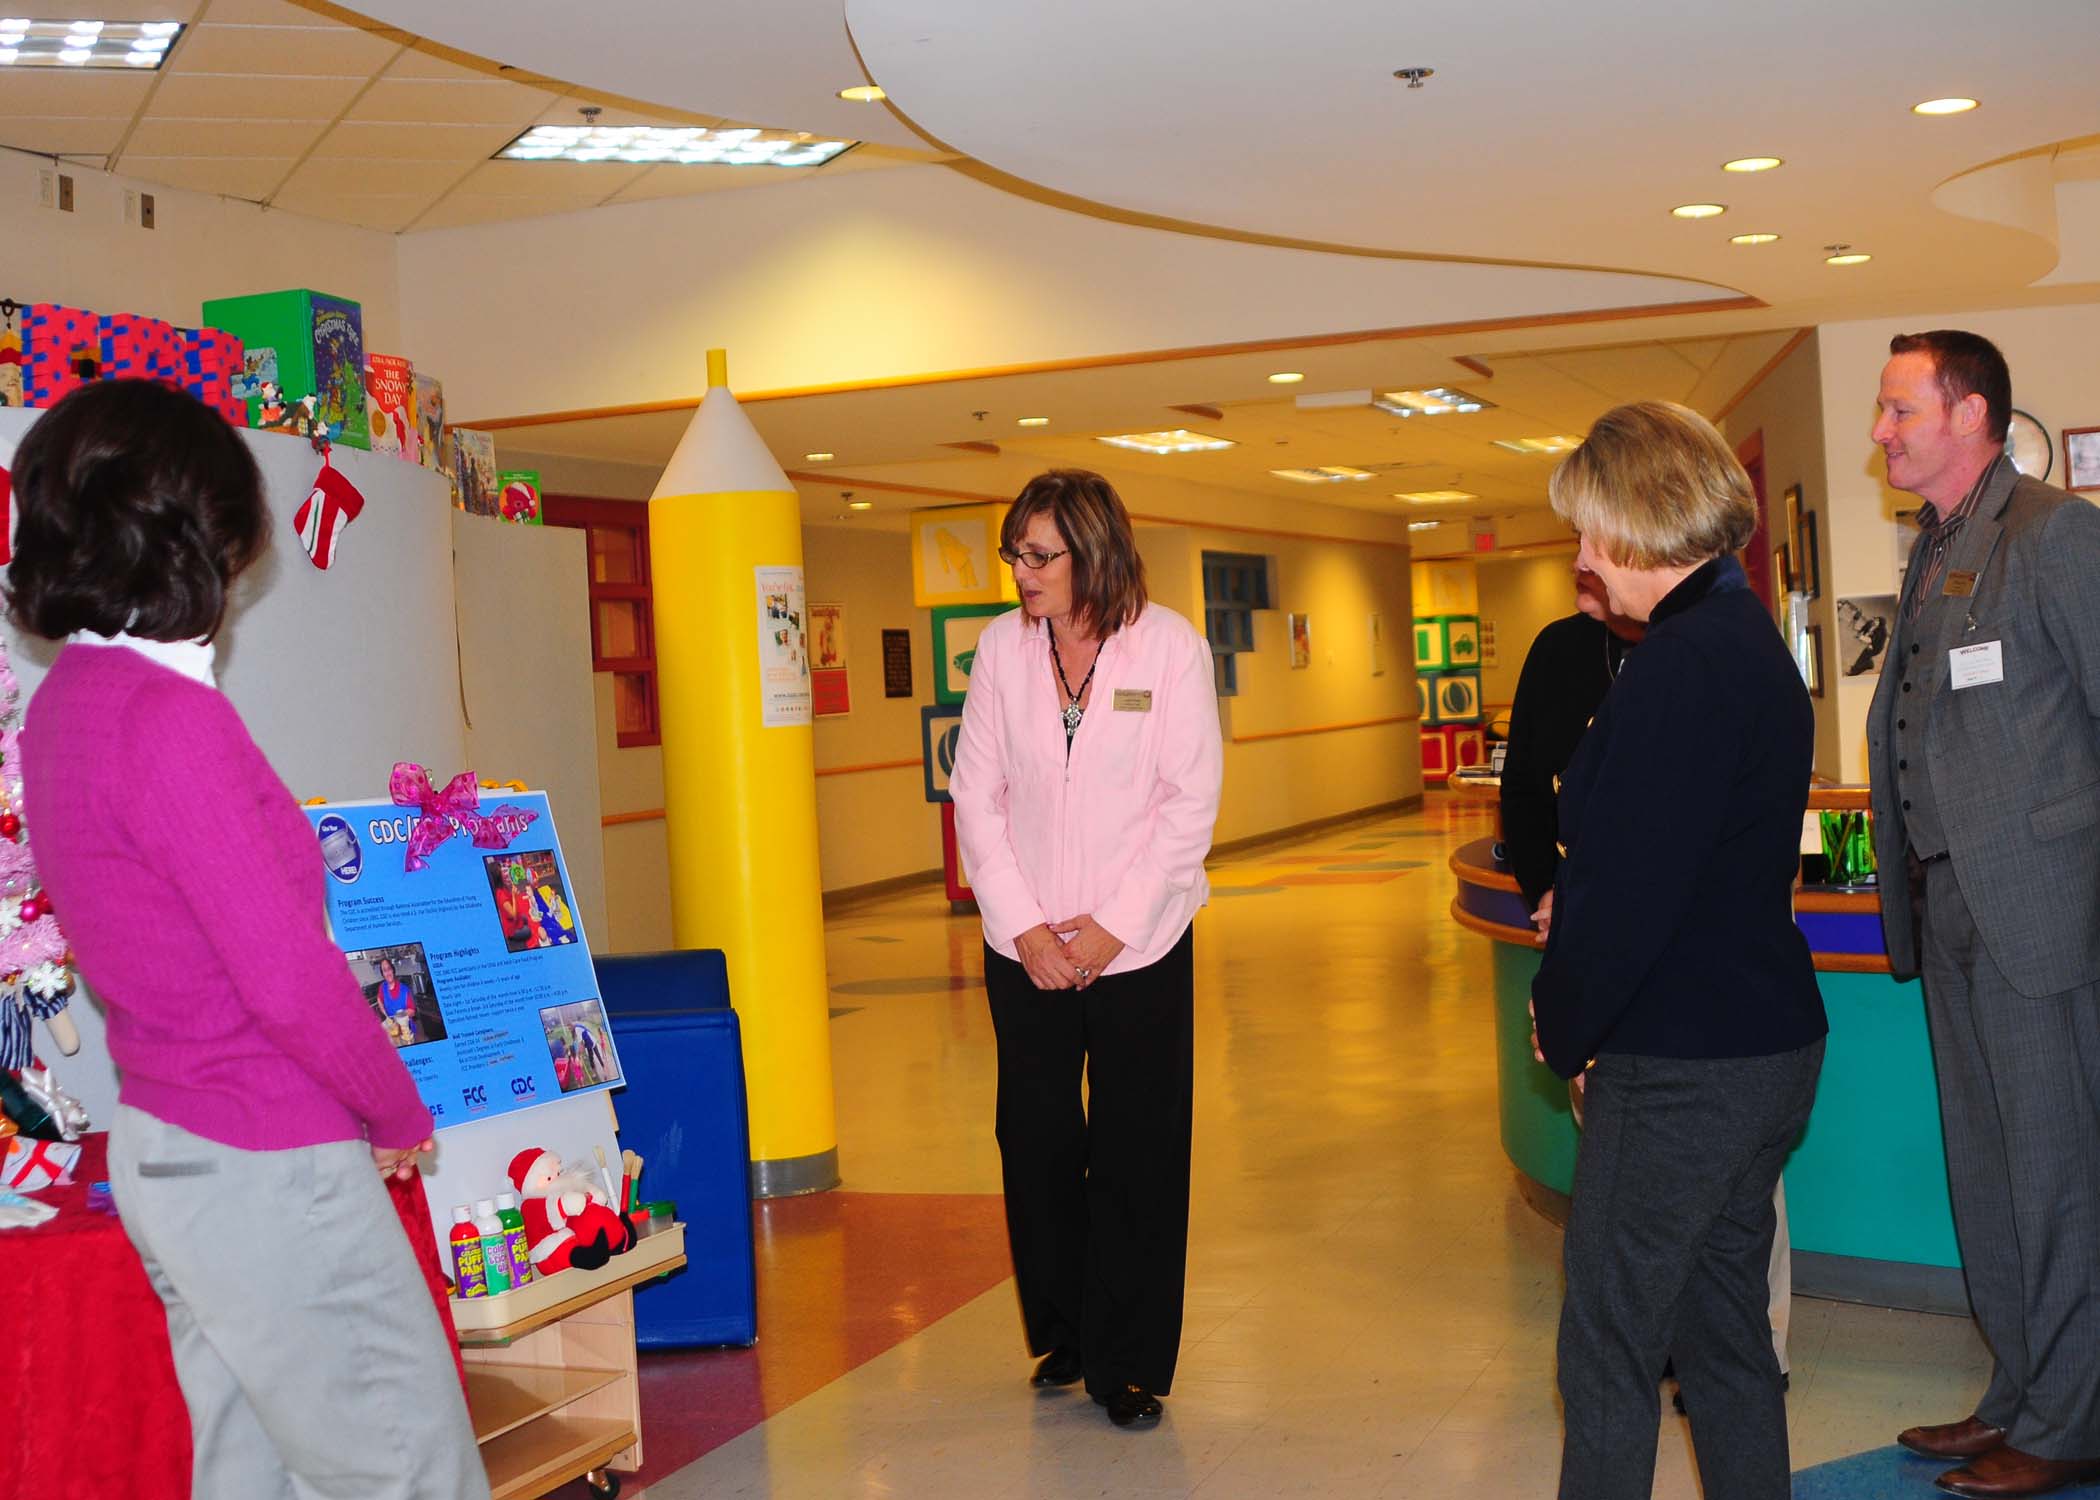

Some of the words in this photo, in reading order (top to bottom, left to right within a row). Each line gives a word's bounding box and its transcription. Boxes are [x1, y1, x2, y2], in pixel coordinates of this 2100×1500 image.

[384, 369, 400, 380] THE
[375, 380, 408, 393] SNOWY
[384, 393, 402, 405] DAY
[430, 951, 452, 960] Program
[511, 1076, 536, 1095] CDC
[462, 1085, 487, 1106] FCC
